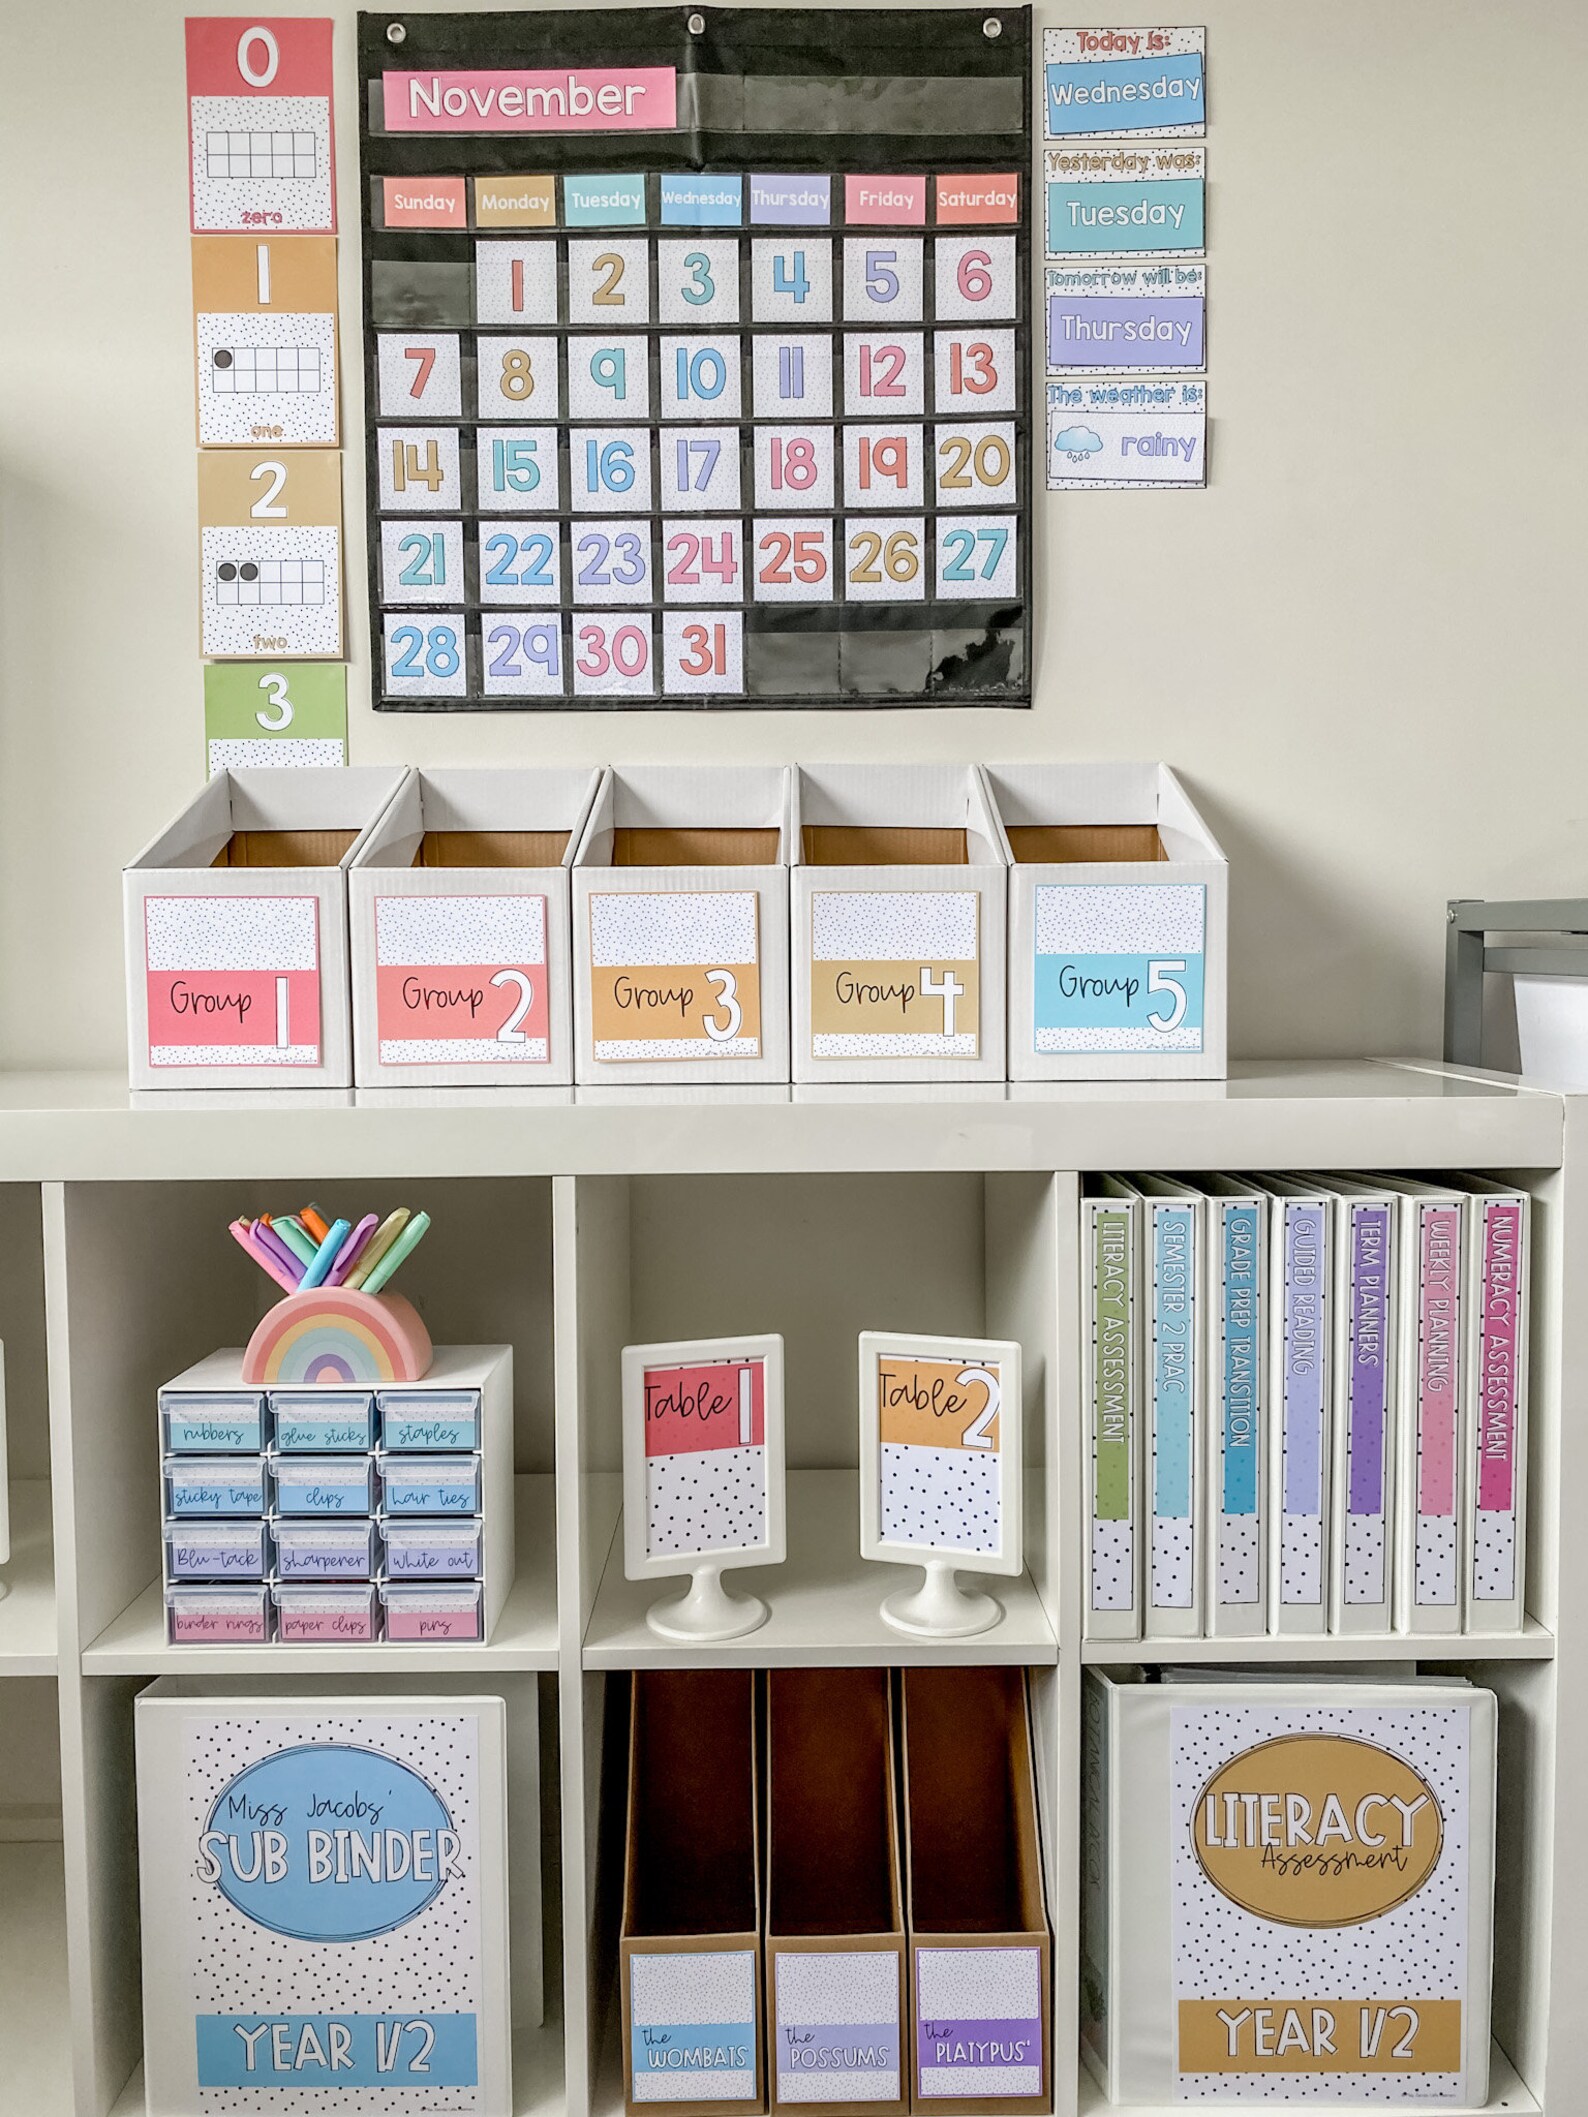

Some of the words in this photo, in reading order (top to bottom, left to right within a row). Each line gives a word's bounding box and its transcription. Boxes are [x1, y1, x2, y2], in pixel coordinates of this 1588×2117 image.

[237, 27, 279, 87] 0
[1077, 32, 1141, 54] Today
[410, 76, 645, 118] November
[1051, 75, 1200, 105] Wednesday
[1048, 153, 1149, 173] Yesterday
[1156, 154, 1200, 169] was:
[242, 210, 282, 225] zero
[394, 194, 455, 212] Sunday
[482, 194, 549, 212] Monday
[572, 192, 640, 209] Tuesday
[662, 190, 741, 208] Wednesday
[752, 191, 829, 209] Thursday
[859, 191, 914, 209] Friday
[939, 191, 1017, 208] Saturday
[1067, 199, 1185, 229] Tuesday
[257, 244, 270, 304] 1
[512, 260, 523, 311] 1
[592, 253, 625, 305] 2
[681, 253, 715, 305] 3
[774, 251, 810, 303] 4
[866, 251, 899, 303] 5
[958, 250, 992, 301] 6
[1048, 271, 1136, 286] Tomorrow
[1142, 268, 1172, 285] will
[1175, 269, 1202, 284] be:
[1061, 315, 1192, 346] Thursday
[404, 348, 435, 399] 7
[499, 349, 534, 400] 8
[590, 348, 626, 399] 9
[676, 347, 726, 399] 10
[779, 347, 803, 398] 11
[860, 345, 906, 397] 12
[950, 343, 997, 394] 13
[1048, 385, 1082, 403] The
[1089, 386, 1175, 403] weather
[1182, 386, 1203, 401] is:
[251, 425, 283, 438] one
[1122, 432, 1196, 462] rainy
[392, 440, 444, 492] 14
[493, 440, 541, 492] 15
[587, 440, 635, 492] 16
[677, 440, 720, 491] 17
[771, 438, 817, 490] 18
[859, 437, 907, 489] 19
[940, 435, 1010, 488] 20
[249, 461, 288, 519] 2
[399, 533, 444, 585] 21
[485, 533, 553, 585] 22
[577, 533, 645, 584] 23
[668, 532, 737, 583] 24
[759, 532, 826, 583] 25
[849, 531, 918, 582] 26
[942, 529, 1008, 580] 27
[253, 634, 288, 650] two
[390, 625, 459, 677] 28
[488, 625, 558, 676] 29
[576, 625, 648, 676] 30
[679, 624, 726, 675] 31
[255, 673, 294, 731] 3
[170, 981, 252, 1023] Group
[275, 977, 288, 1049] 1
[402, 977, 483, 1017] Group
[489, 969, 534, 1043] 2
[614, 976, 694, 1017] Group
[702, 968, 742, 1042] 3
[835, 971, 915, 1013] Group
[919, 966, 964, 1037] 4
[1059, 965, 1139, 1007] Group
[1146, 959, 1188, 1033] 5
[1102, 1222, 1124, 1308] LITERACY
[1163, 1220, 1185, 1313] SEMESTER
[1230, 1220, 1251, 1281] GRADE
[1293, 1220, 1316, 1286] GUIDED
[1360, 1220, 1381, 1267] TERM
[1428, 1221, 1450, 1291] WEEKLY
[1488, 1216, 1513, 1325] NUMERACY
[1163, 1322, 1186, 1335] 2
[1230, 1288, 1250, 1328] PREP
[1357, 1275, 1381, 1366] PLANNERS
[1291, 1294, 1315, 1375] READING
[1427, 1299, 1449, 1391] PLANNING
[1102, 1316, 1124, 1443] ASSESSMENT
[1162, 1341, 1184, 1392] PRAC
[1229, 1336, 1251, 1447] TRANSITION
[644, 1381, 732, 1421] Table
[738, 1367, 751, 1444] 1
[880, 1373, 967, 1417] Table
[955, 1368, 1000, 1448] 2
[1486, 1334, 1510, 1460] ASSESSMENT
[183, 1423, 244, 1444] rubbers
[281, 1426, 316, 1444] glue
[325, 1425, 366, 1444] sticks
[399, 1423, 460, 1444] staples
[176, 1485, 221, 1509] sticky
[230, 1487, 262, 1504] tape
[306, 1484, 345, 1507] clips
[392, 1487, 430, 1505] hair
[438, 1487, 470, 1507] ties
[177, 1549, 259, 1567] Blu-tack
[284, 1550, 365, 1570] sharpener
[393, 1549, 439, 1569] white
[448, 1552, 473, 1568] out
[177, 1615, 219, 1630] binder
[226, 1619, 264, 1634] rings
[285, 1619, 324, 1634] paper
[332, 1616, 366, 1634] clips
[420, 1619, 452, 1635] pins
[228, 1794, 288, 1826] Miss
[307, 1789, 392, 1824] Jacobs'
[1205, 1792, 1429, 1848] LITERACY
[196, 1830, 288, 1884] SUB
[307, 1830, 463, 1884] BINDER
[1261, 1843, 1408, 1876] Assessment
[233, 2022, 355, 2072] YEAR
[377, 2020, 435, 2073] 1/2
[642, 2028, 671, 2046] the
[785, 2028, 815, 2044] the
[924, 2022, 954, 2040] the
[936, 2040, 1031, 2063] PLATYPUS'
[1217, 2008, 1337, 2057] YEAR
[1360, 2005, 1420, 2058] 1/2
[648, 2046, 749, 2068] WOMBATS
[790, 2046, 890, 2068] POSSUMS
